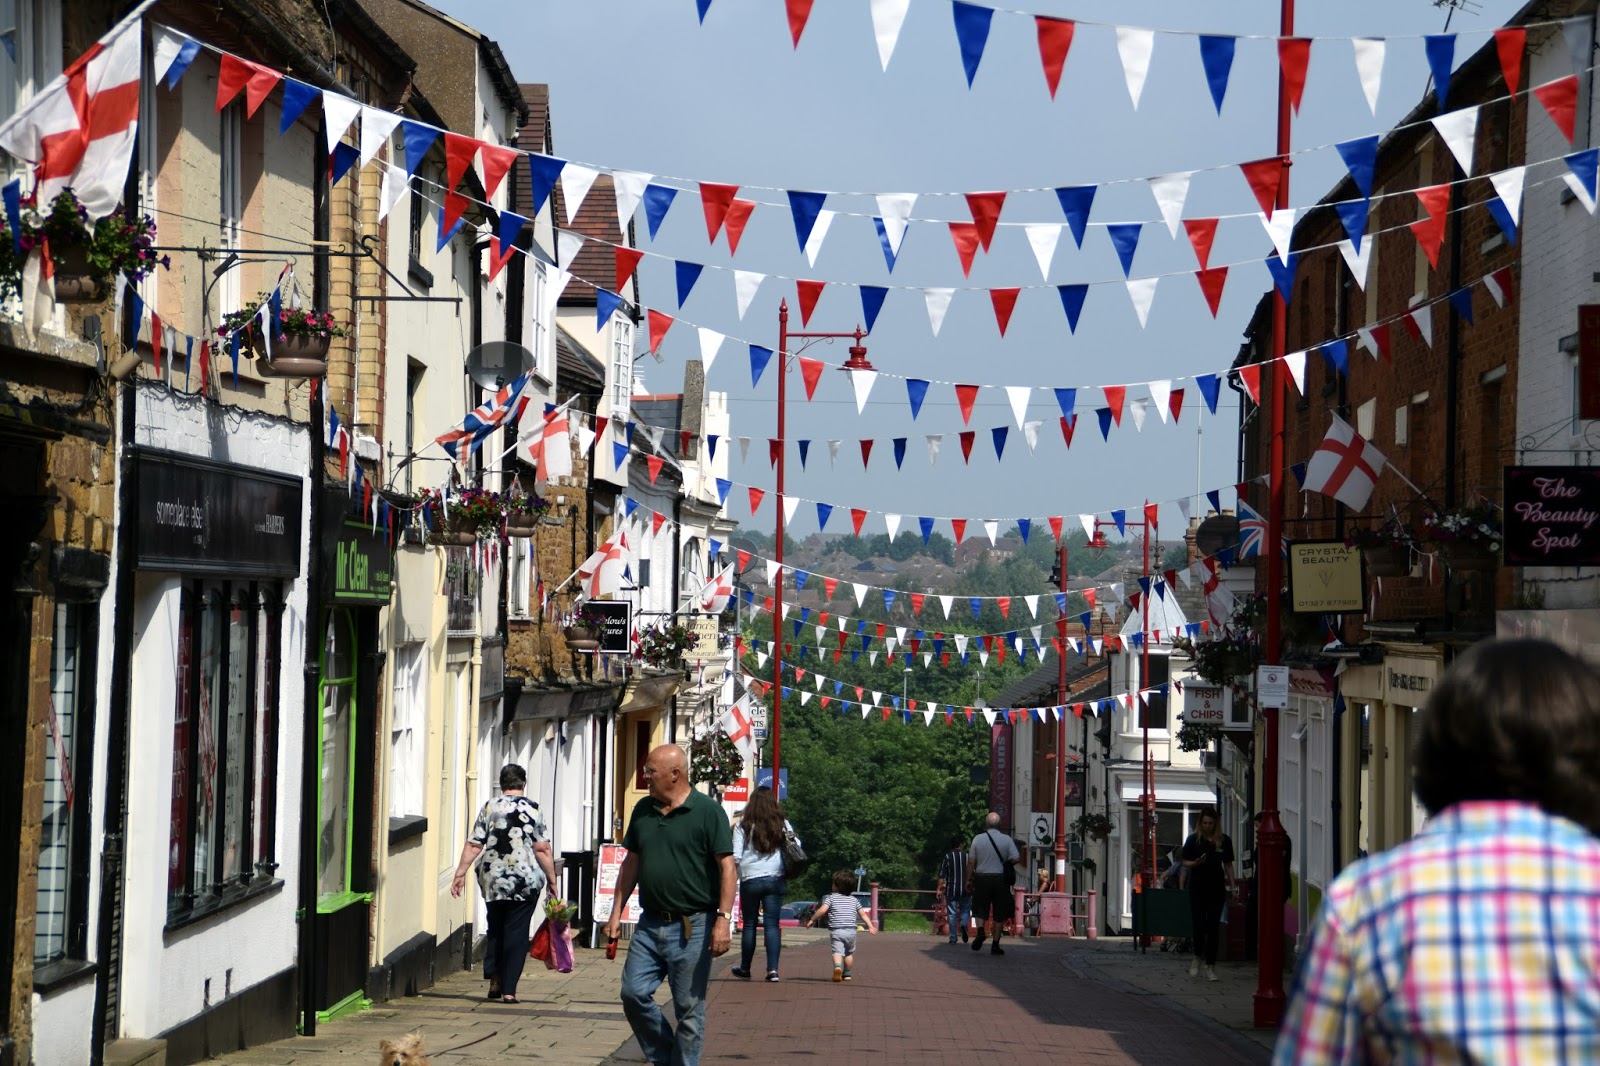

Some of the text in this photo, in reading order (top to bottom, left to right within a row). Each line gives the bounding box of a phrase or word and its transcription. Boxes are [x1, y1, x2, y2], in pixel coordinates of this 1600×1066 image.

[1533, 477, 1582, 498] The
[1514, 502, 1600, 529] Beauty
[1531, 527, 1582, 555] Spot
[1298, 547, 1353, 556] CRYSTAL
[336, 538, 369, 591] Mr Clean
[1302, 556, 1349, 565] BEAUTY
[1194, 689, 1220, 699] FISH
[1203, 700, 1211, 709] &
[1190, 709, 1224, 720] CHIPS
